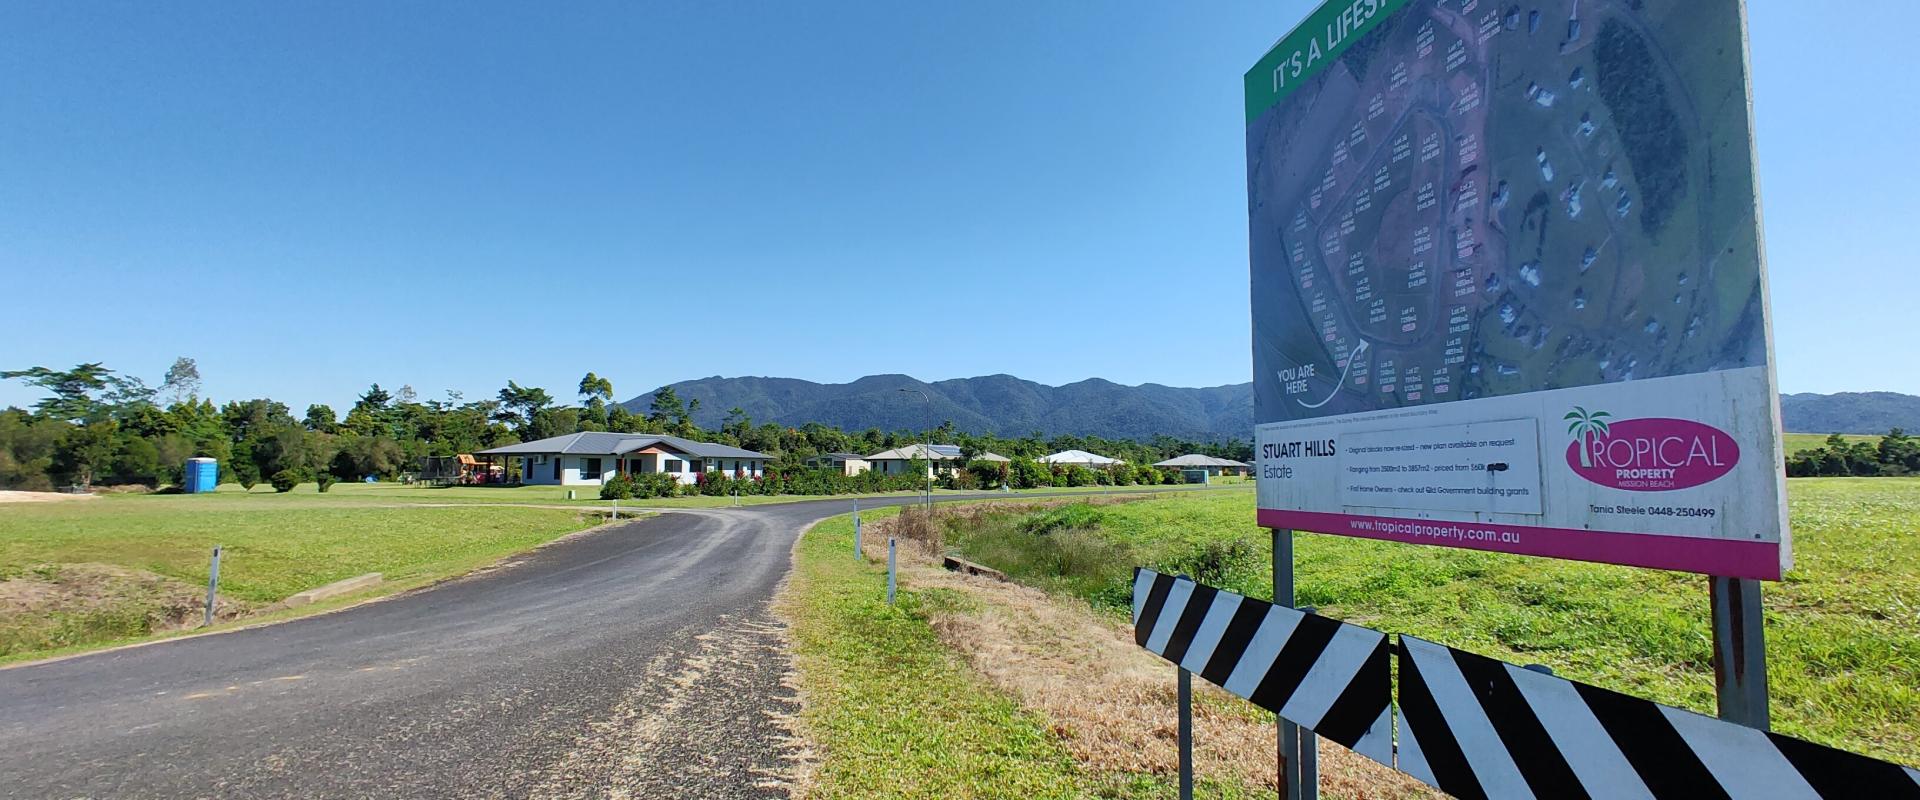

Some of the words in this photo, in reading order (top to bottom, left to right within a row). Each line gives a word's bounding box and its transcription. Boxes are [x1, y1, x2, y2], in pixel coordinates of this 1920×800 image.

[1273, 50, 1302, 93] IT'S
[1306, 37, 1322, 68] A
[1327, 0, 1386, 51] LIFES
[1277, 368, 1296, 382] YOU
[1298, 364, 1315, 378] ARE
[1286, 380, 1308, 394] HERE
[1263, 441, 1301, 459] STUART
[1305, 439, 1336, 457] HILLS
[1433, 442, 1447, 450] plan
[1448, 440, 1477, 449] available
[1489, 438, 1515, 448] request
[1264, 464, 1292, 479] Estate
[1434, 464, 1454, 472] priced
[1616, 468, 1676, 479] PROPERTY
[1618, 480, 1649, 488] MISSION
[1649, 480, 1675, 488] BEACH
[1437, 486, 1476, 495] Government
[1476, 487, 1505, 497] building
[1506, 487, 1530, 497] grants
[1589, 504, 1614, 514] Tania
[1616, 505, 1646, 515] Steele
[1648, 506, 1715, 518] 0448-250499
[1350, 518, 1520, 544] www.tropicalproperty.com.au
